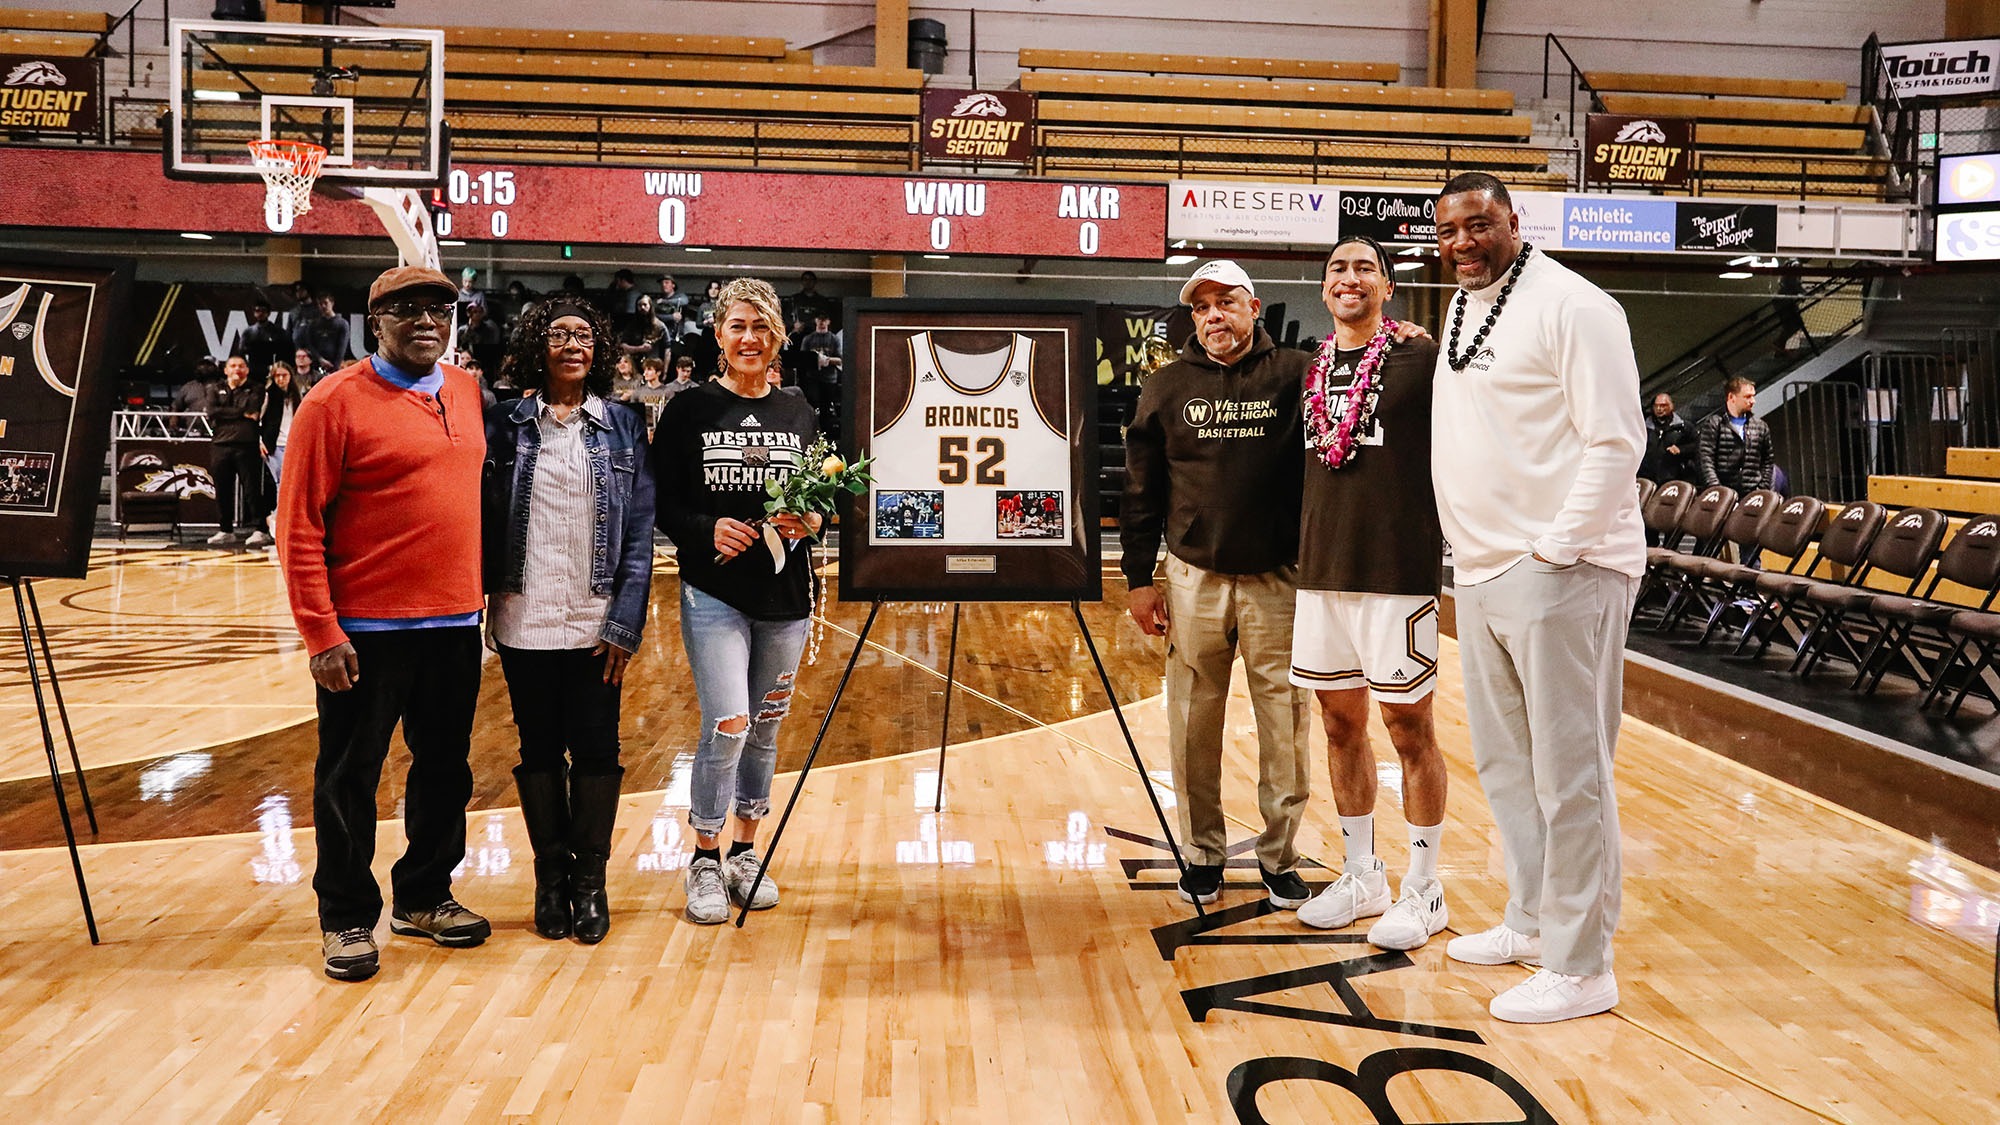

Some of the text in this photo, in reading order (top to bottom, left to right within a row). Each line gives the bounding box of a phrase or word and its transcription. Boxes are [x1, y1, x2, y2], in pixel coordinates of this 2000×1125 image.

[1885, 50, 1991, 78] Touch
[0, 110, 70, 127] SECTION
[930, 118, 1024, 142] STUDENT
[945, 139, 1009, 156] SECTION
[1594, 143, 1682, 167] STUDENT
[643, 171, 703, 197] WMU
[1608, 165, 1667, 181] SECTION
[448, 168, 517, 206] 0:15
[903, 180, 987, 217] WMU
[1057, 184, 1121, 220] AKR
[1376, 197, 1421, 222] Gallivan
[491, 209, 508, 238] 0
[658, 197, 686, 244] 0
[1568, 206, 1633, 224] Athletic
[1691, 216, 1707, 227] The
[1699, 213, 1738, 239] SPIRIT
[930, 216, 951, 251] 0
[1078, 220, 1100, 256] 0
[1519, 223, 1557, 232] scension
[1568, 224, 1671, 244] Performance
[1716, 227, 1754, 248] Shoppe
[925, 405, 1019, 430] BRONCOS
[1215, 399, 1271, 412] WESTERN
[1215, 408, 1278, 424] MICHIGAN
[701, 430, 803, 450] WESTERN
[1197, 426, 1266, 439] BASKETBALL
[938, 435, 1007, 487] 52
[703, 465, 801, 486] MICHIGA
